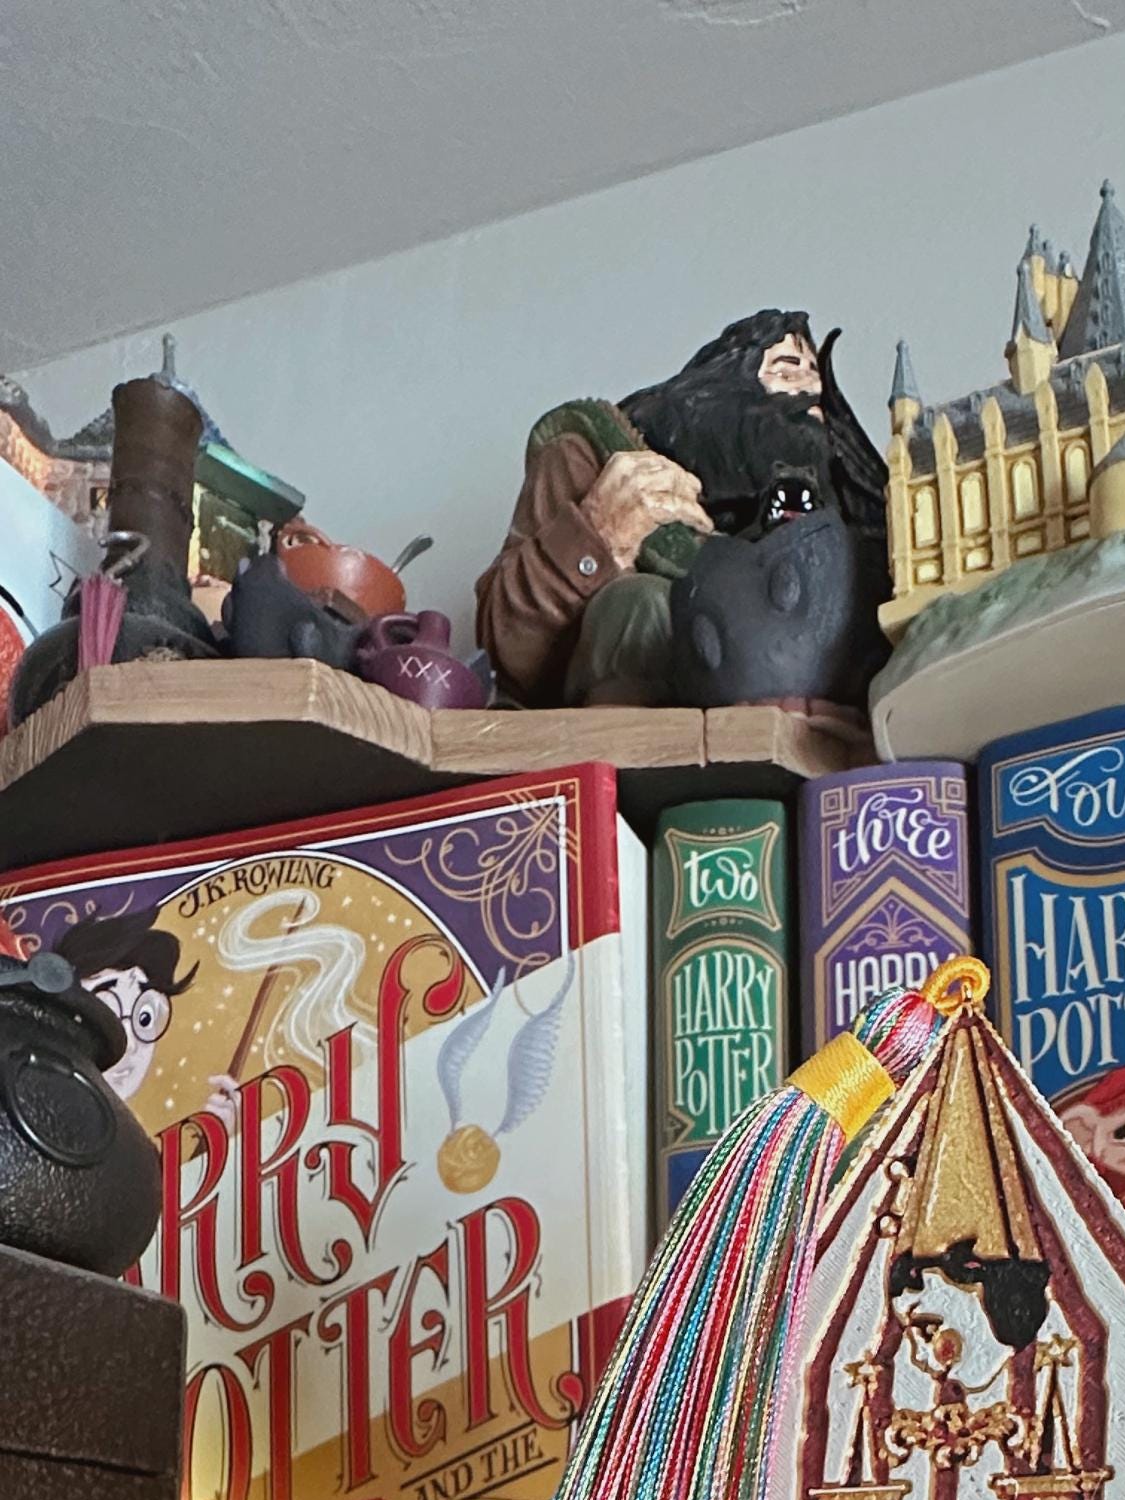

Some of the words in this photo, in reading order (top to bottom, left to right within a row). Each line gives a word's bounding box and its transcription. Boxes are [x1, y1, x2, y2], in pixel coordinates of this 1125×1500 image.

[834, 787, 953, 872] three
[683, 847, 759, 908] two
[674, 949, 774, 1038] HARRY
[675, 1031, 774, 1136] POTTER
[119, 932, 468, 1333] RRY
[480, 1427, 545, 1491] THE
